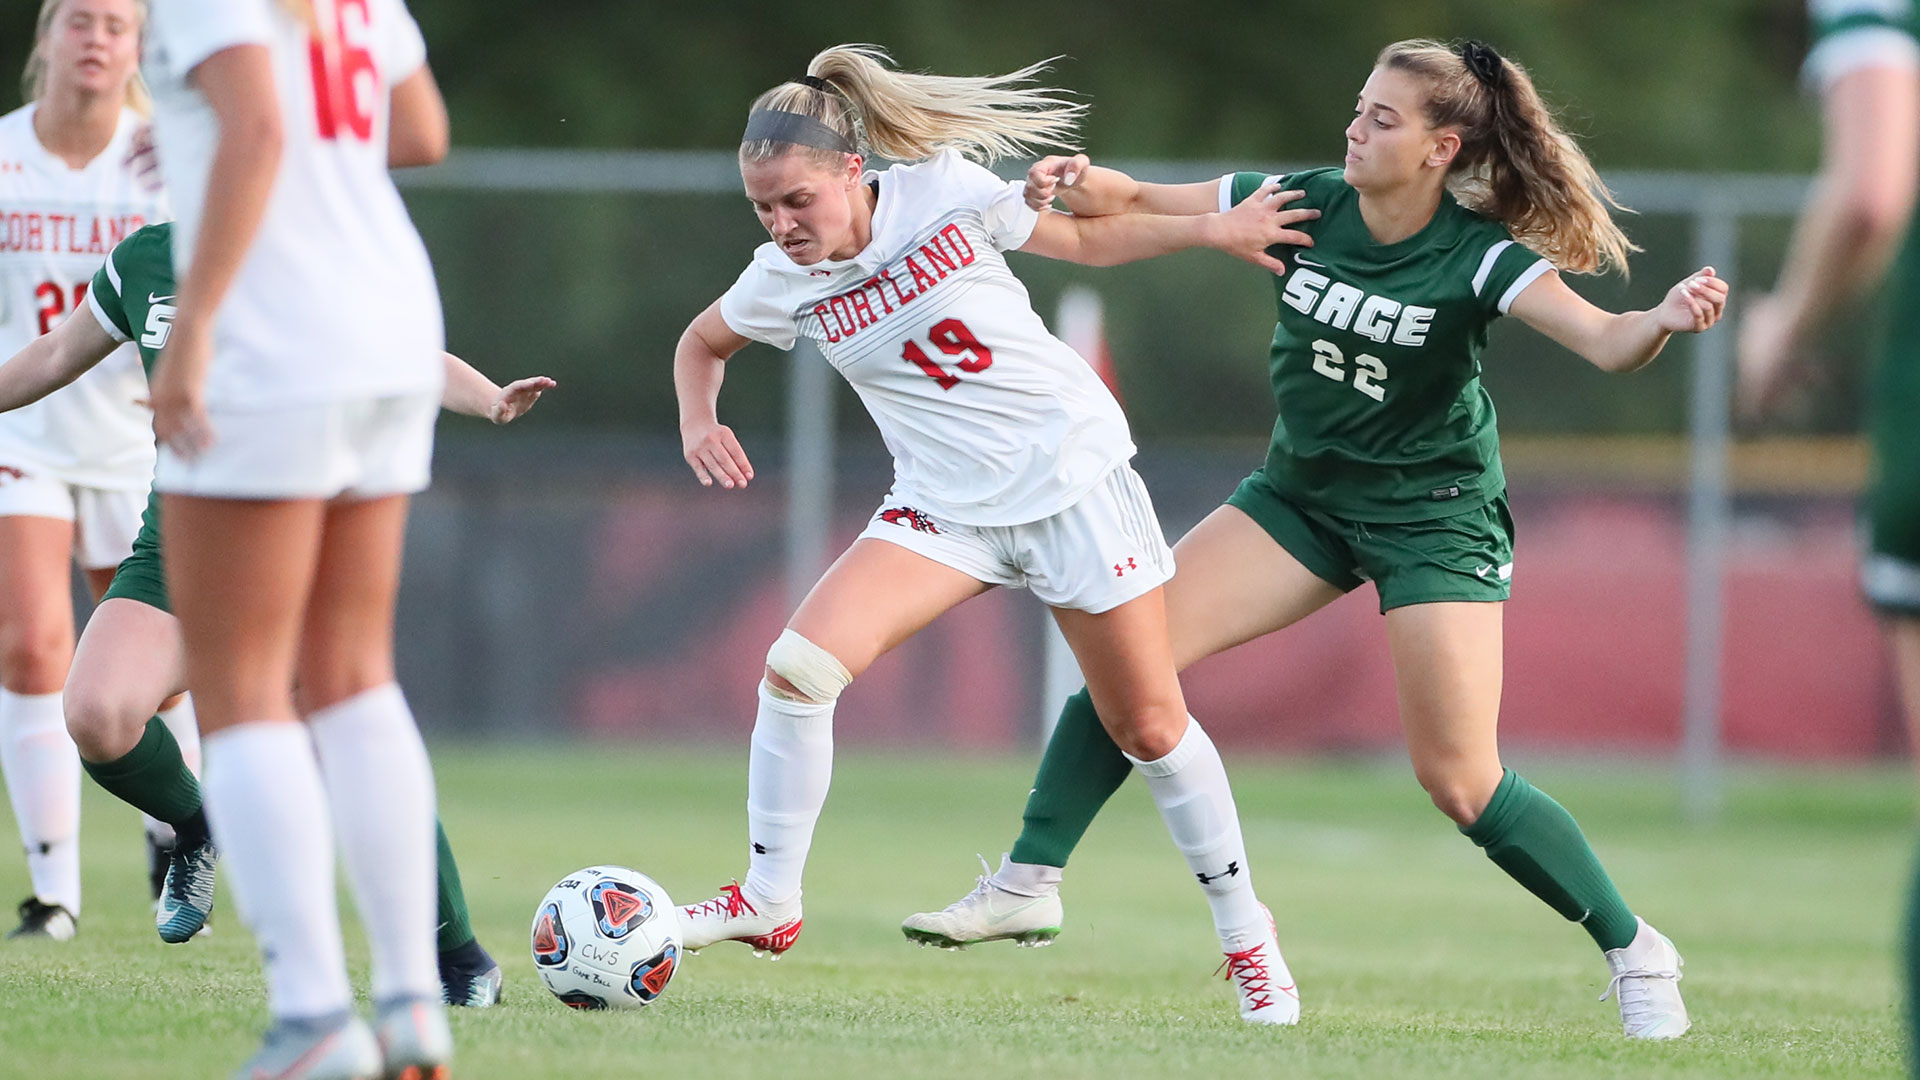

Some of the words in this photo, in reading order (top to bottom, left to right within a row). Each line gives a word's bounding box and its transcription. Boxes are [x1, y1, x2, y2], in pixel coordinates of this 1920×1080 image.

[309, 0, 378, 141] 16
[814, 223, 975, 343] CORTLAND
[1282, 267, 1436, 347] SAGE
[901, 318, 993, 391] 19
[1311, 338, 1388, 402] 22
[581, 943, 620, 966] CWS
